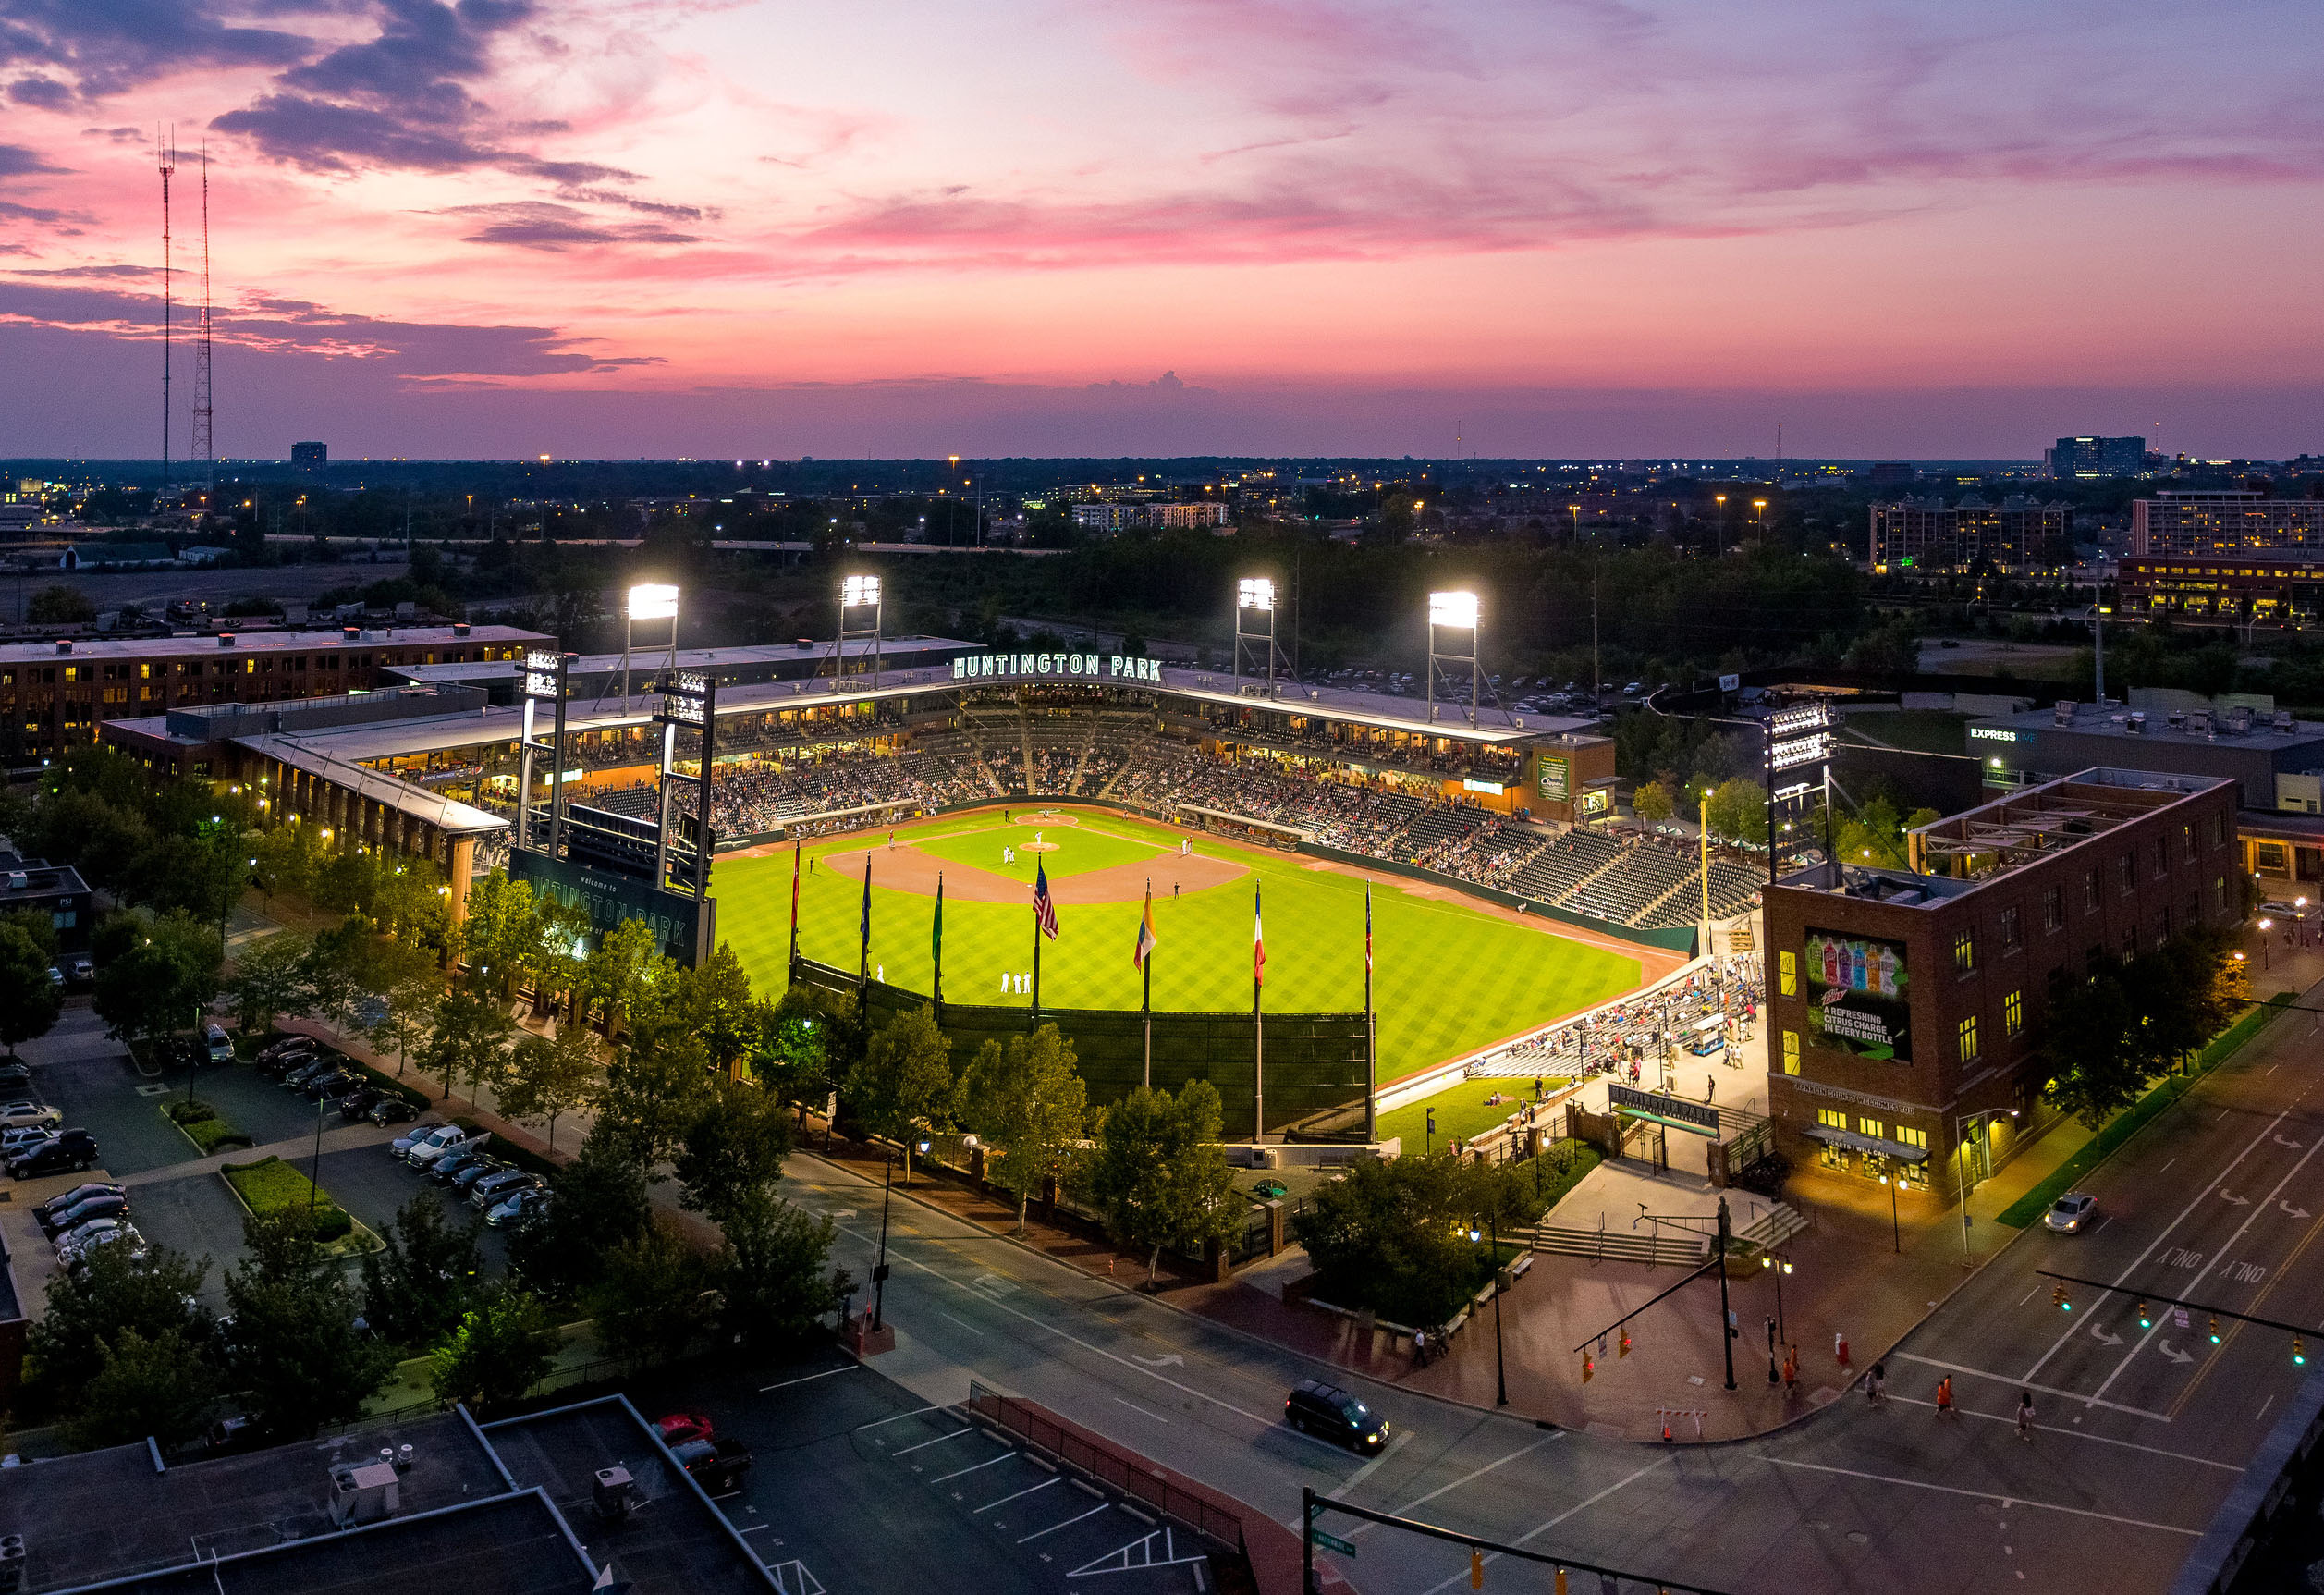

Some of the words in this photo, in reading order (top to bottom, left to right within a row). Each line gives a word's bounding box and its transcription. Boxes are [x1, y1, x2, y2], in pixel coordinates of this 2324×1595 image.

[954, 654, 1099, 679] HUNTINGTON
[1111, 656, 1161, 681] PARK
[1971, 728, 2016, 742] EXPRESS
[580, 876, 607, 890] welcome
[609, 884, 617, 892] to
[636, 908, 687, 948] PARK
[1824, 1005, 1829, 1014] A
[1830, 1007, 1882, 1025] REFRESHING
[1824, 1014, 1853, 1028] CITRUS
[1853, 1020, 1887, 1035] CHARGE
[1824, 1023, 1833, 1033] IN
[1835, 1025, 1860, 1038] EVERY
[1861, 1031, 1893, 1045] BOTTLE
[1612, 1086, 1679, 1113] HUNTINGTON
[1682, 1105, 1711, 1121] PARK
[1899, 1105, 1914, 1115] YOU
[1824, 1138, 1851, 1150] TICKETS
[1856, 1146, 1872, 1155] WILL
[1873, 1149, 1890, 1159] CALL
[2155, 1246, 2203, 1269] ONLY
[2219, 1260, 2267, 1283] ONLY
